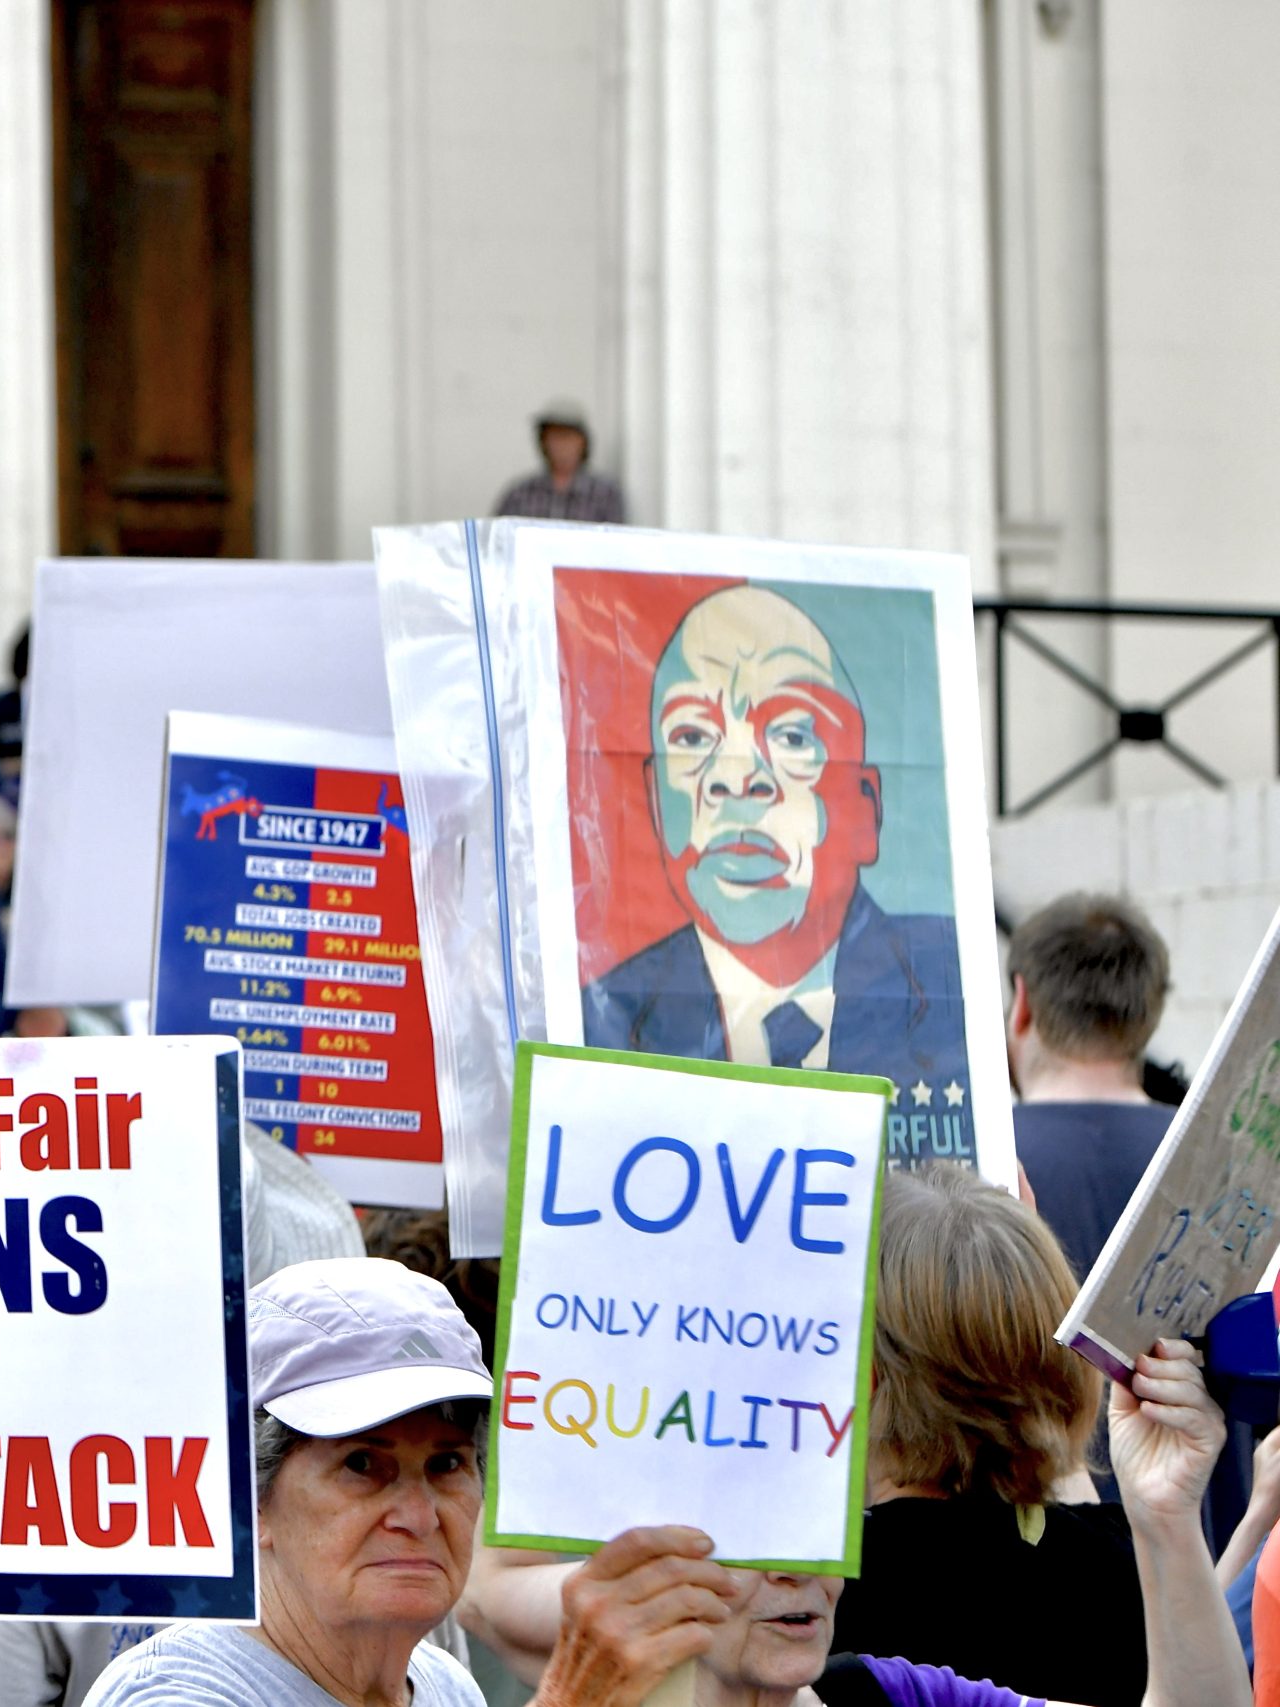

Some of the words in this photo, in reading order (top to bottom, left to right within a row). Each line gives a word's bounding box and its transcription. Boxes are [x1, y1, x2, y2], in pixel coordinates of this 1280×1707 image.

[257, 814, 317, 843] SINCE
[319, 819, 369, 846] 1947
[283, 863, 310, 877] GDP
[313, 866, 373, 882] GROWTH
[253, 883, 297, 903] 4.3%
[326, 888, 353, 908] 2.5
[240, 905, 279, 921] TOTAL
[284, 910, 317, 926] JOBS
[319, 914, 378, 932] CREATED
[184, 925, 222, 945] 70.5
[225, 929, 294, 951] MILLION
[324, 936, 359, 956] 29.1
[364, 941, 421, 961] MILLIO
[240, 956, 282, 972] STOCK
[285, 959, 338, 977] MARKET
[341, 964, 404, 982] RETURNS
[240, 977, 291, 1000] 11.2%
[320, 985, 363, 1006] 6.9%
[246, 1005, 357, 1026] UNEMPLOYMENT
[360, 1012, 393, 1029] RATE
[318, 1033, 372, 1054] 6.01%
[293, 1057, 345, 1075] DURING
[349, 1062, 386, 1078] TERM
[318, 1081, 340, 1099] 10
[274, 1104, 325, 1120] FELONY
[327, 1108, 419, 1129] CONVICTIONS
[313, 1129, 336, 1148] 34
[888, 1114, 971, 1155] RFUL
[541, 1124, 856, 1255] LOVE
[535, 1293, 659, 1337] ONLY
[675, 1303, 840, 1356] KNOWS
[501, 1370, 856, 1458] EQUALITY
